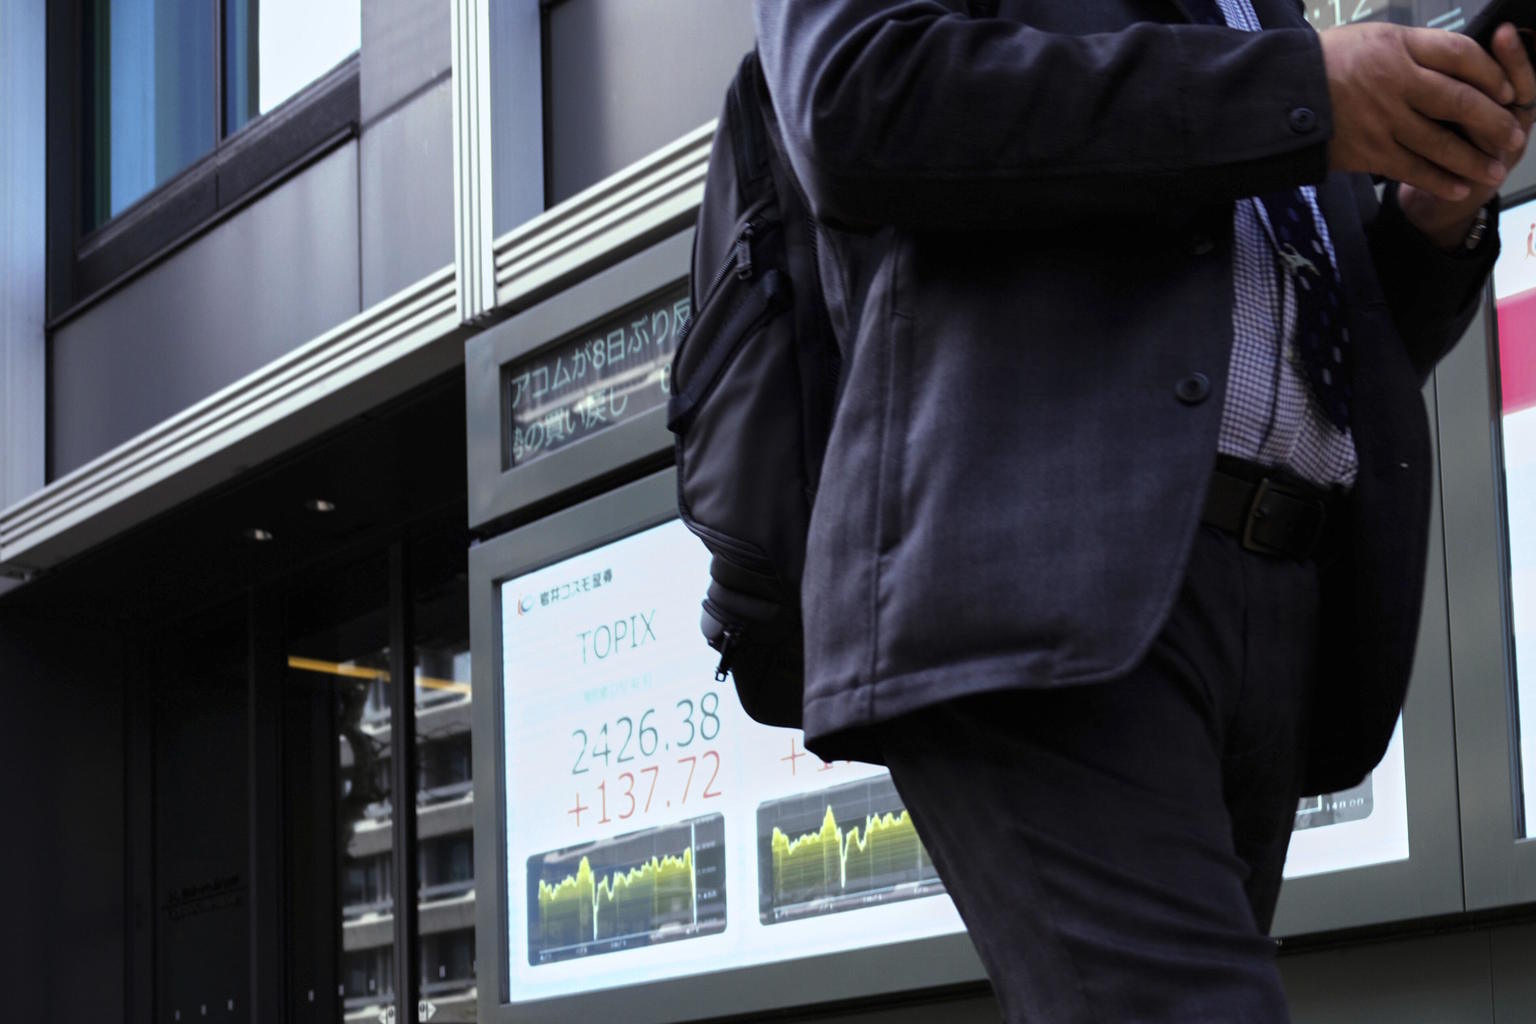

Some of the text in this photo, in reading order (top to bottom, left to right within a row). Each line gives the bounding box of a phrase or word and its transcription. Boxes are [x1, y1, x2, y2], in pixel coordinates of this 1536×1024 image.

[577, 599, 657, 664] TOPIX
[571, 691, 721, 775] 2426.38
[567, 749, 722, 828] +137.72
